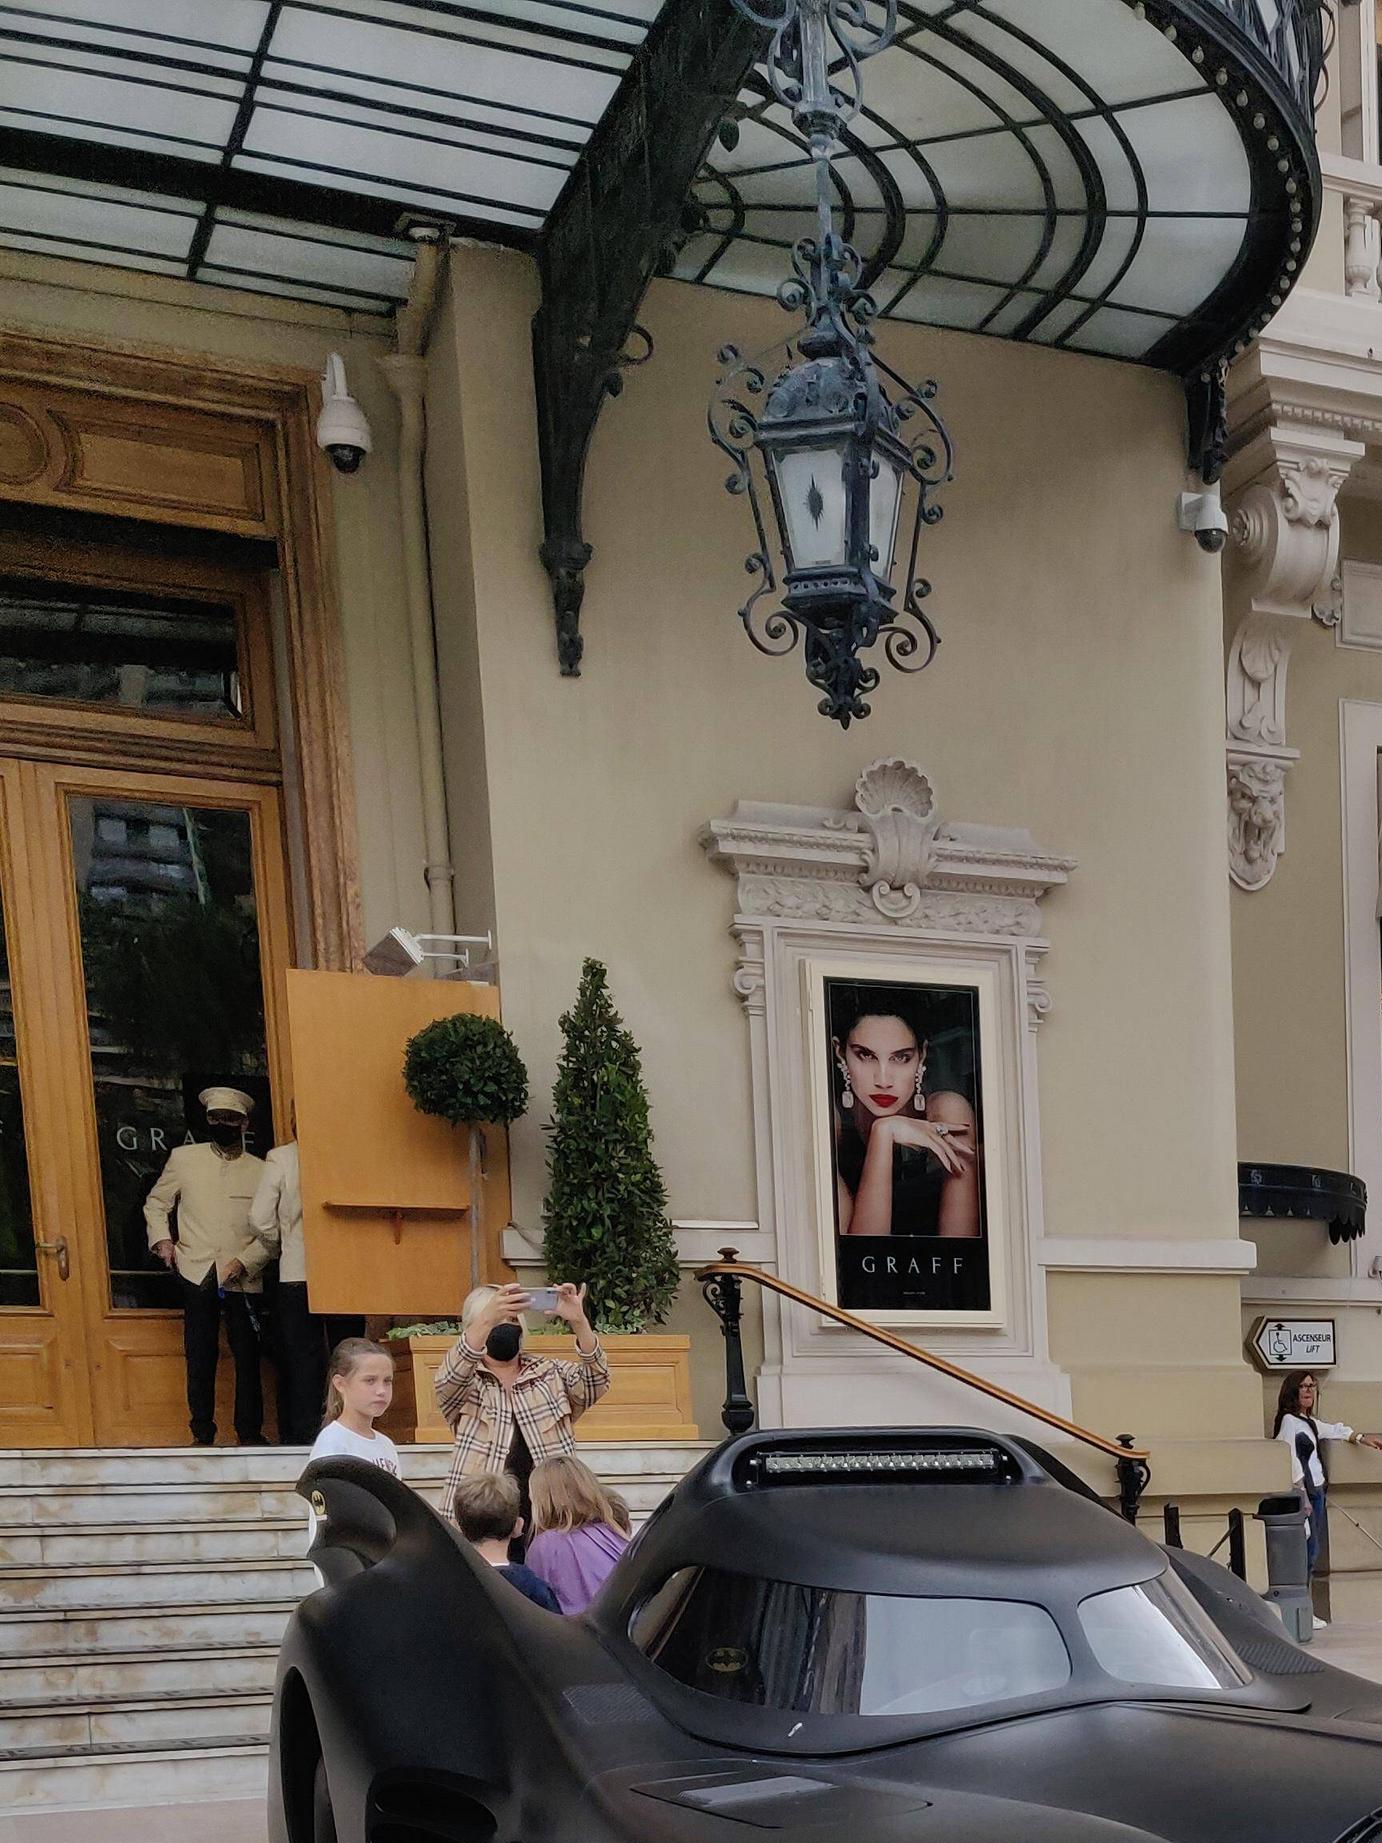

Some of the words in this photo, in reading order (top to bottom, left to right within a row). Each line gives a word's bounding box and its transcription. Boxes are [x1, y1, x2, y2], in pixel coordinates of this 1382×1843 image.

[116, 1126, 256, 1152] GRAF
[862, 1256, 964, 1274] GRAFF
[1293, 1333, 1331, 1342] ASCENSEUR
[1306, 1345, 1320, 1353] LIFT
